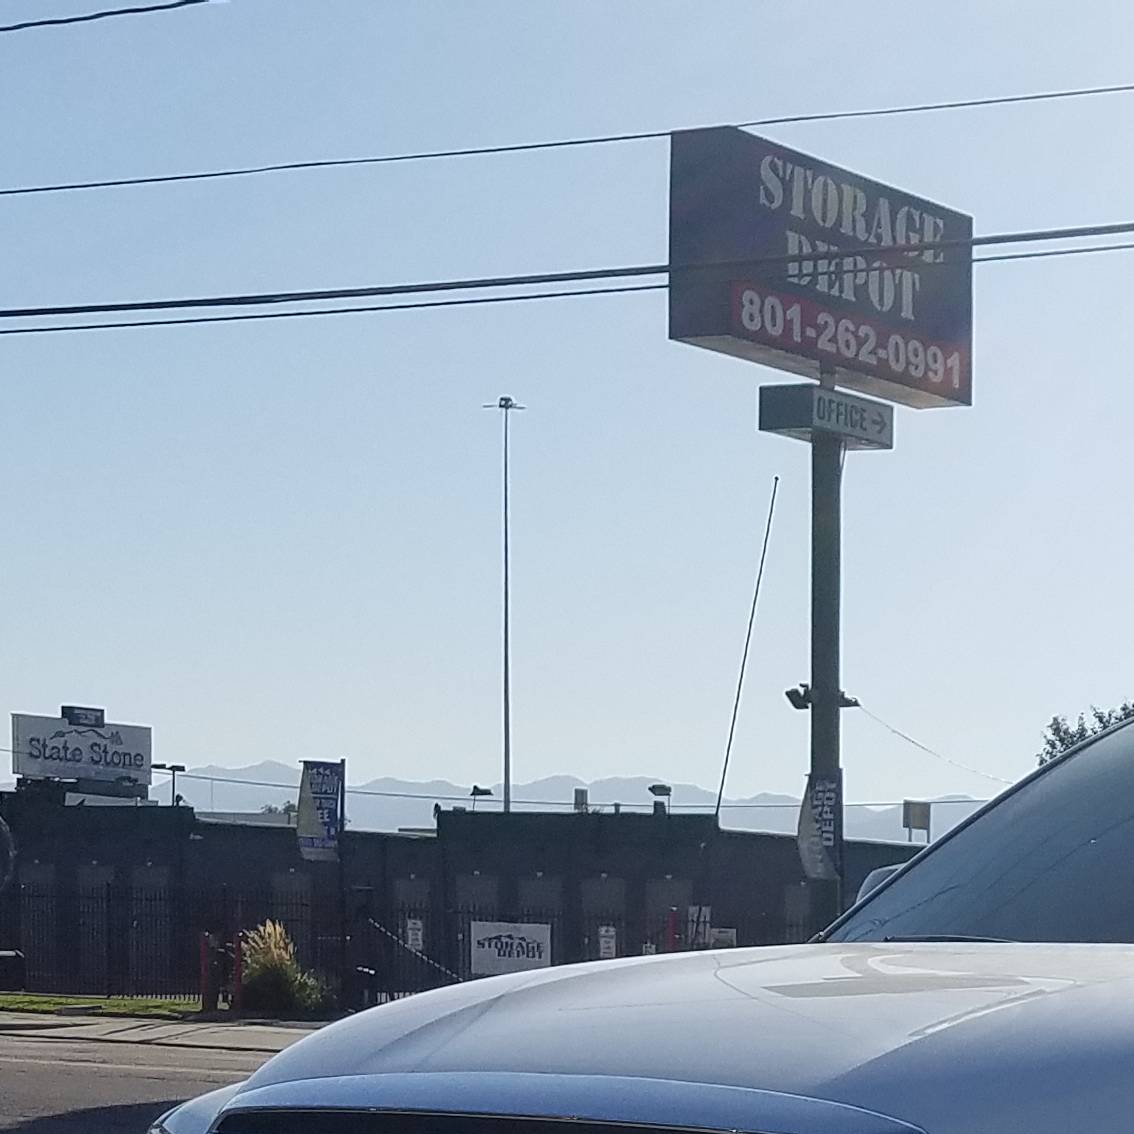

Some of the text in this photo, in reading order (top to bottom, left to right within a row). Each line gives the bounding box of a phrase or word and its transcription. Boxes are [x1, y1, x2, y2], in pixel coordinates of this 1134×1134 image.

[759, 155, 945, 264] STORAGE
[786, 230, 921, 321] DEPOT
[741, 289, 961, 389] 801-262-0991
[817, 396, 868, 432] OFFICE
[29, 737, 145, 768] State Stone
